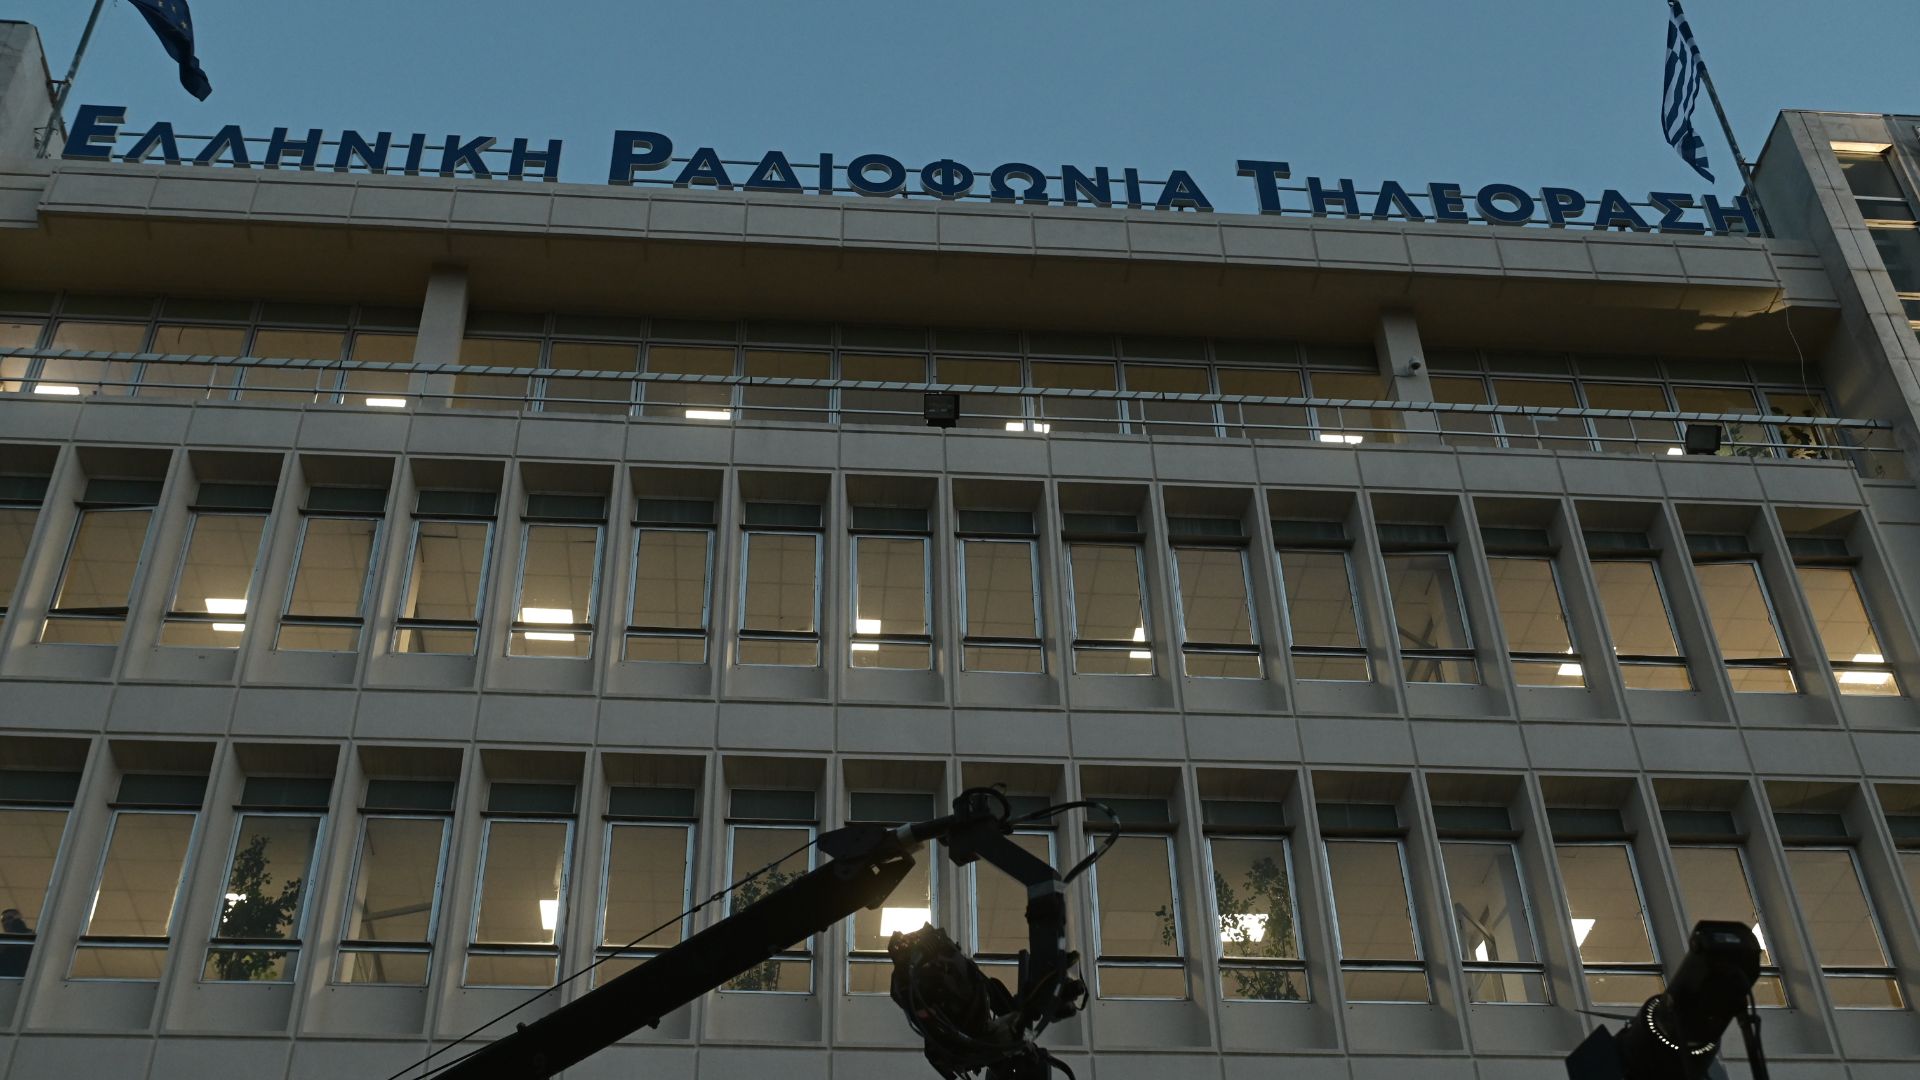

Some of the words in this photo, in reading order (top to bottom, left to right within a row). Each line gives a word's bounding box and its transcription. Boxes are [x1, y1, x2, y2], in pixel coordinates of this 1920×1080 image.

[62, 104, 562, 182] ΕΛΛΗΝΙΚΗ
[608, 130, 1214, 212] ΡΑΔΙΟΦΩΝΙΑ
[1236, 160, 1761, 237] ΤΗΛΕΟΡΑΣΗ
